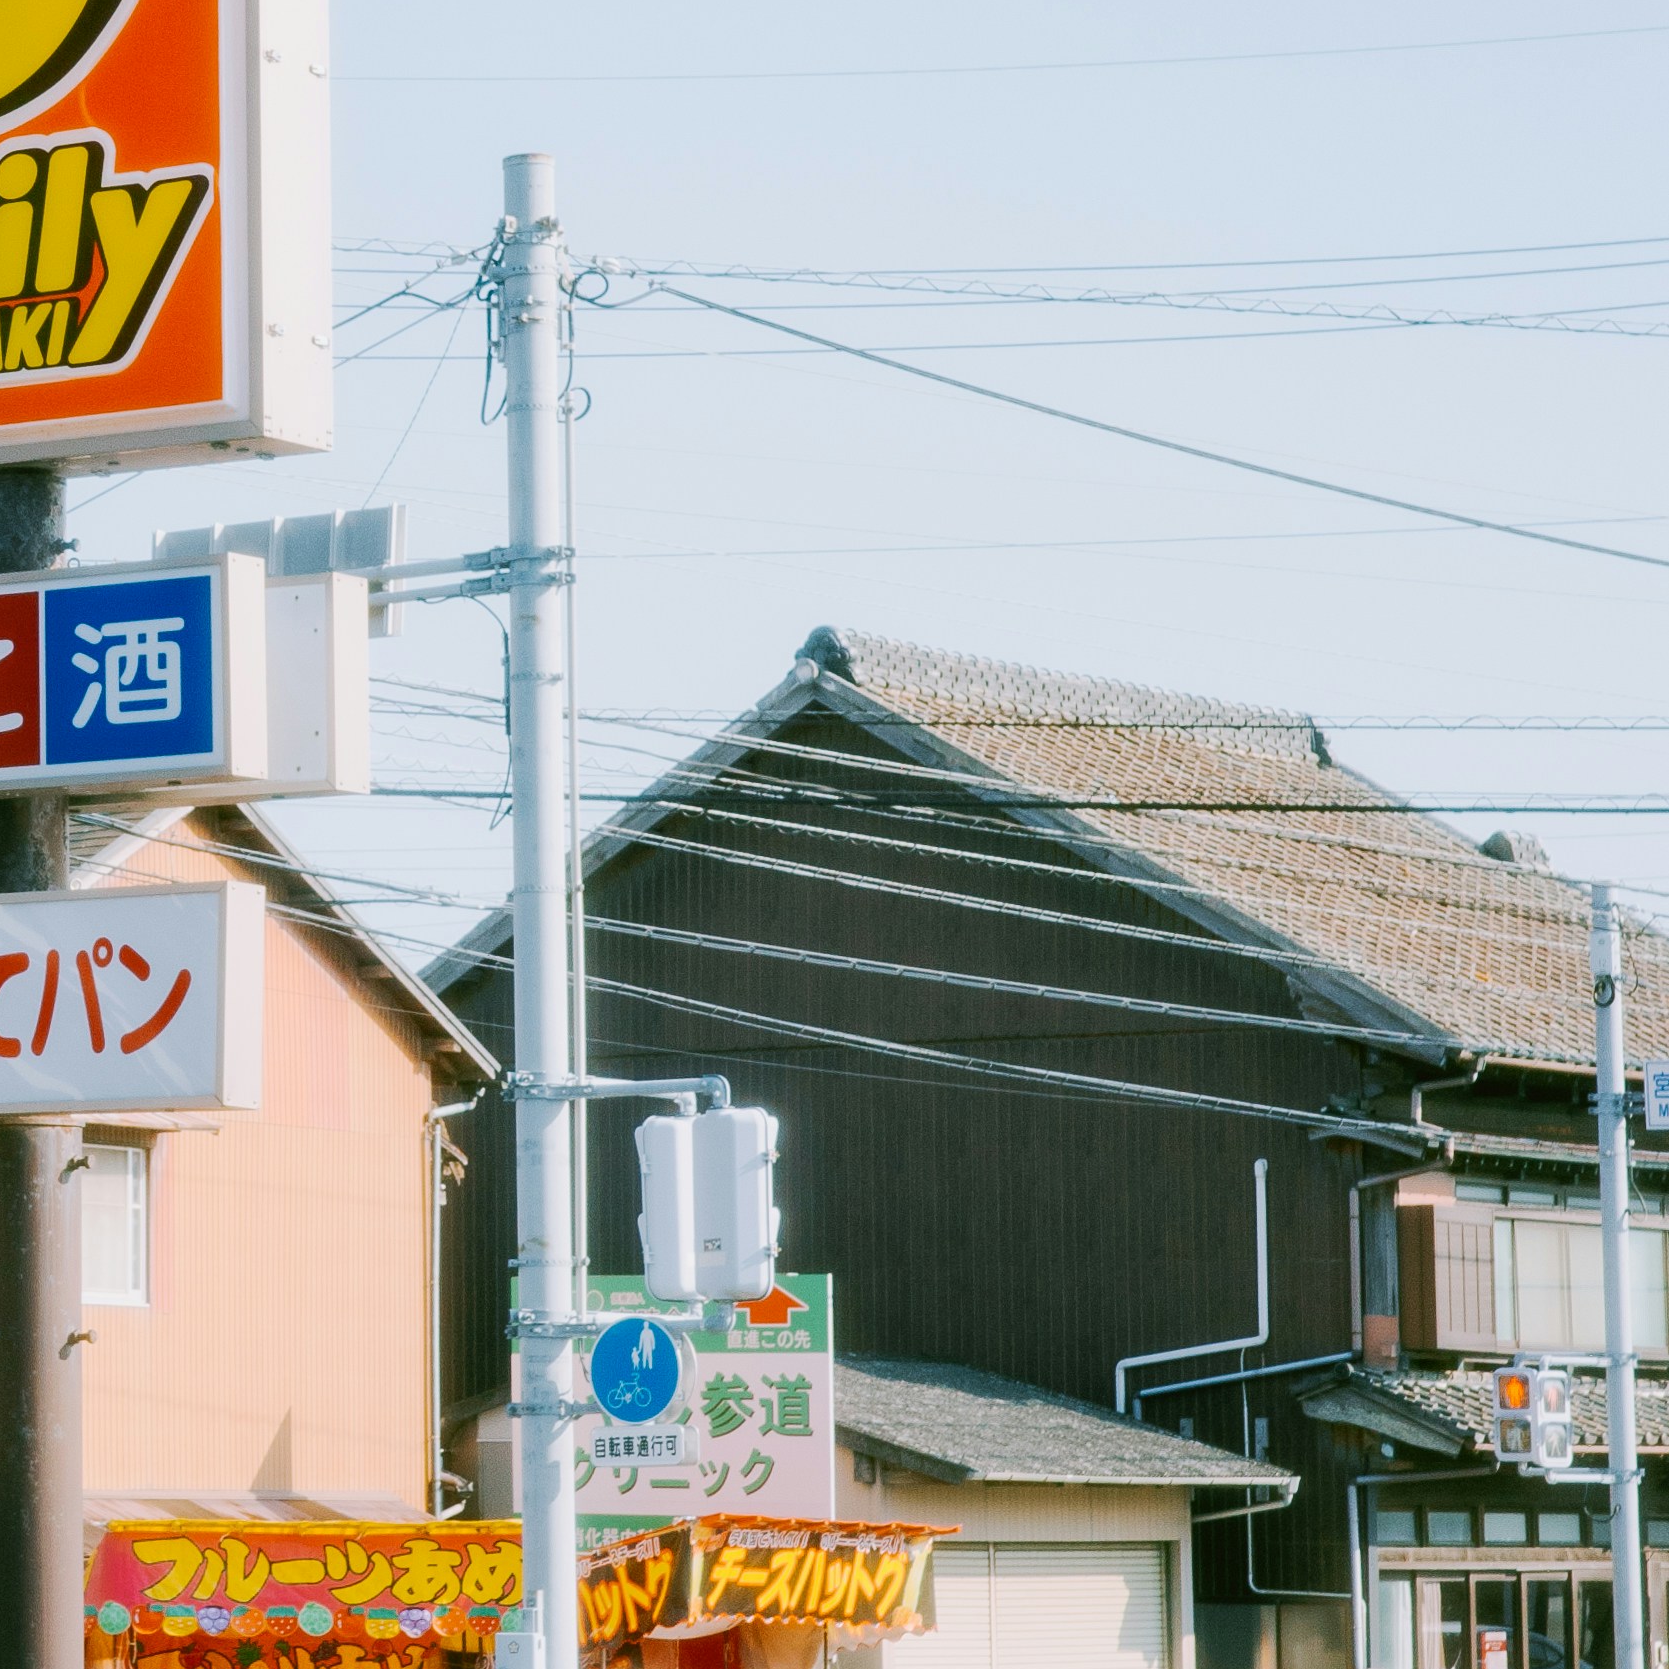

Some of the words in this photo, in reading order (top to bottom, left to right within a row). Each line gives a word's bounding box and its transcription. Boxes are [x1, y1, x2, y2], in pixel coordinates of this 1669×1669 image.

[71, 616, 186, 729] 酒
[727, 1329, 812, 1349] 直進この先
[594, 1434, 678, 1459] 自転車通行可
[132, 1536, 523, 1606] フルーツあめ
[706, 1546, 909, 1621] チーズハットグ
